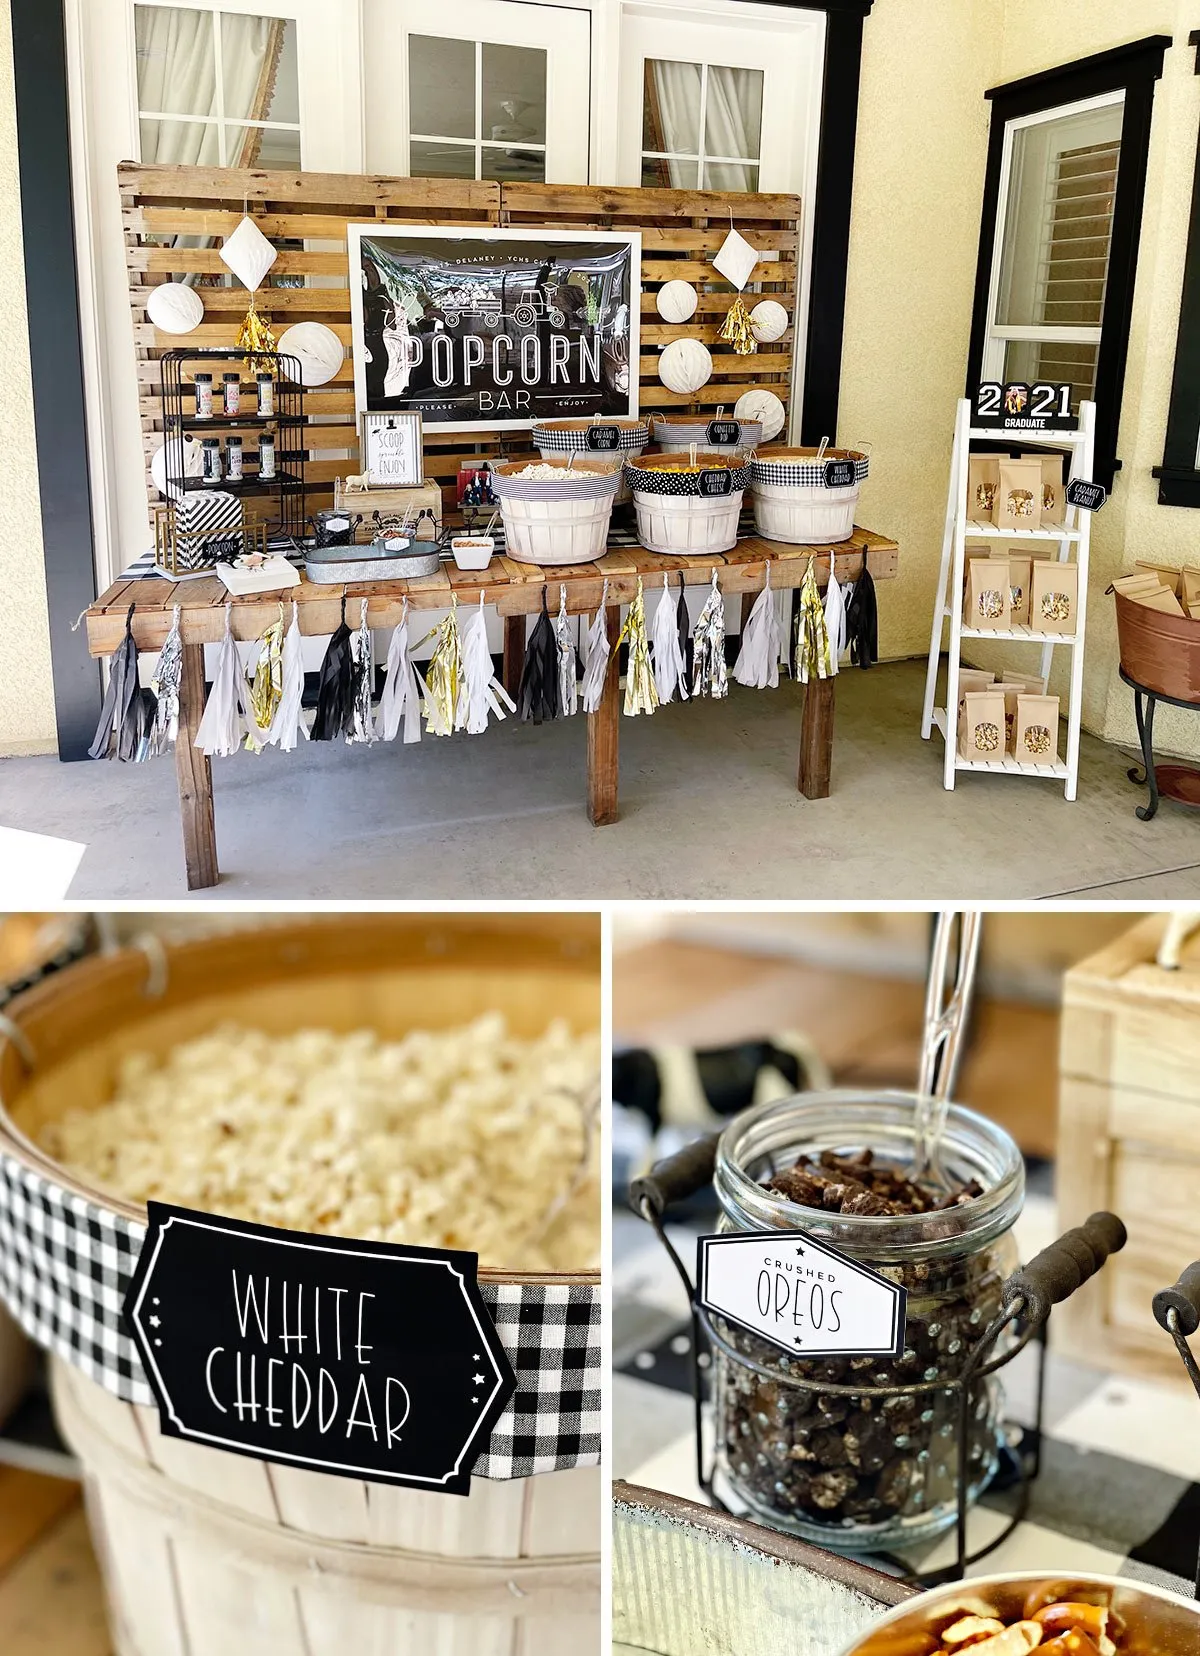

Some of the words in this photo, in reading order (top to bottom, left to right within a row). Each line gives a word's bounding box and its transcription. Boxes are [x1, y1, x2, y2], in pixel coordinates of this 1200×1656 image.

[456, 255, 495, 265] DELANEY
[404, 334, 601, 387] POPCORN
[479, 390, 531, 411] BAR
[1004, 418, 1046, 429] GRADUATE
[378, 431, 404, 449] SCOOP
[592, 430, 615, 440] CARAMEL
[379, 459, 406, 475] ENJOY
[704, 472, 728, 484] CHEDDAR
[1074, 484, 1100, 499] CARAMEL
[764, 1257, 836, 1283] CRUSHED
[757, 1269, 843, 1333] OREOS
[232, 1269, 376, 1365] WHITE
[205, 1346, 411, 1449] CHEDDAR
